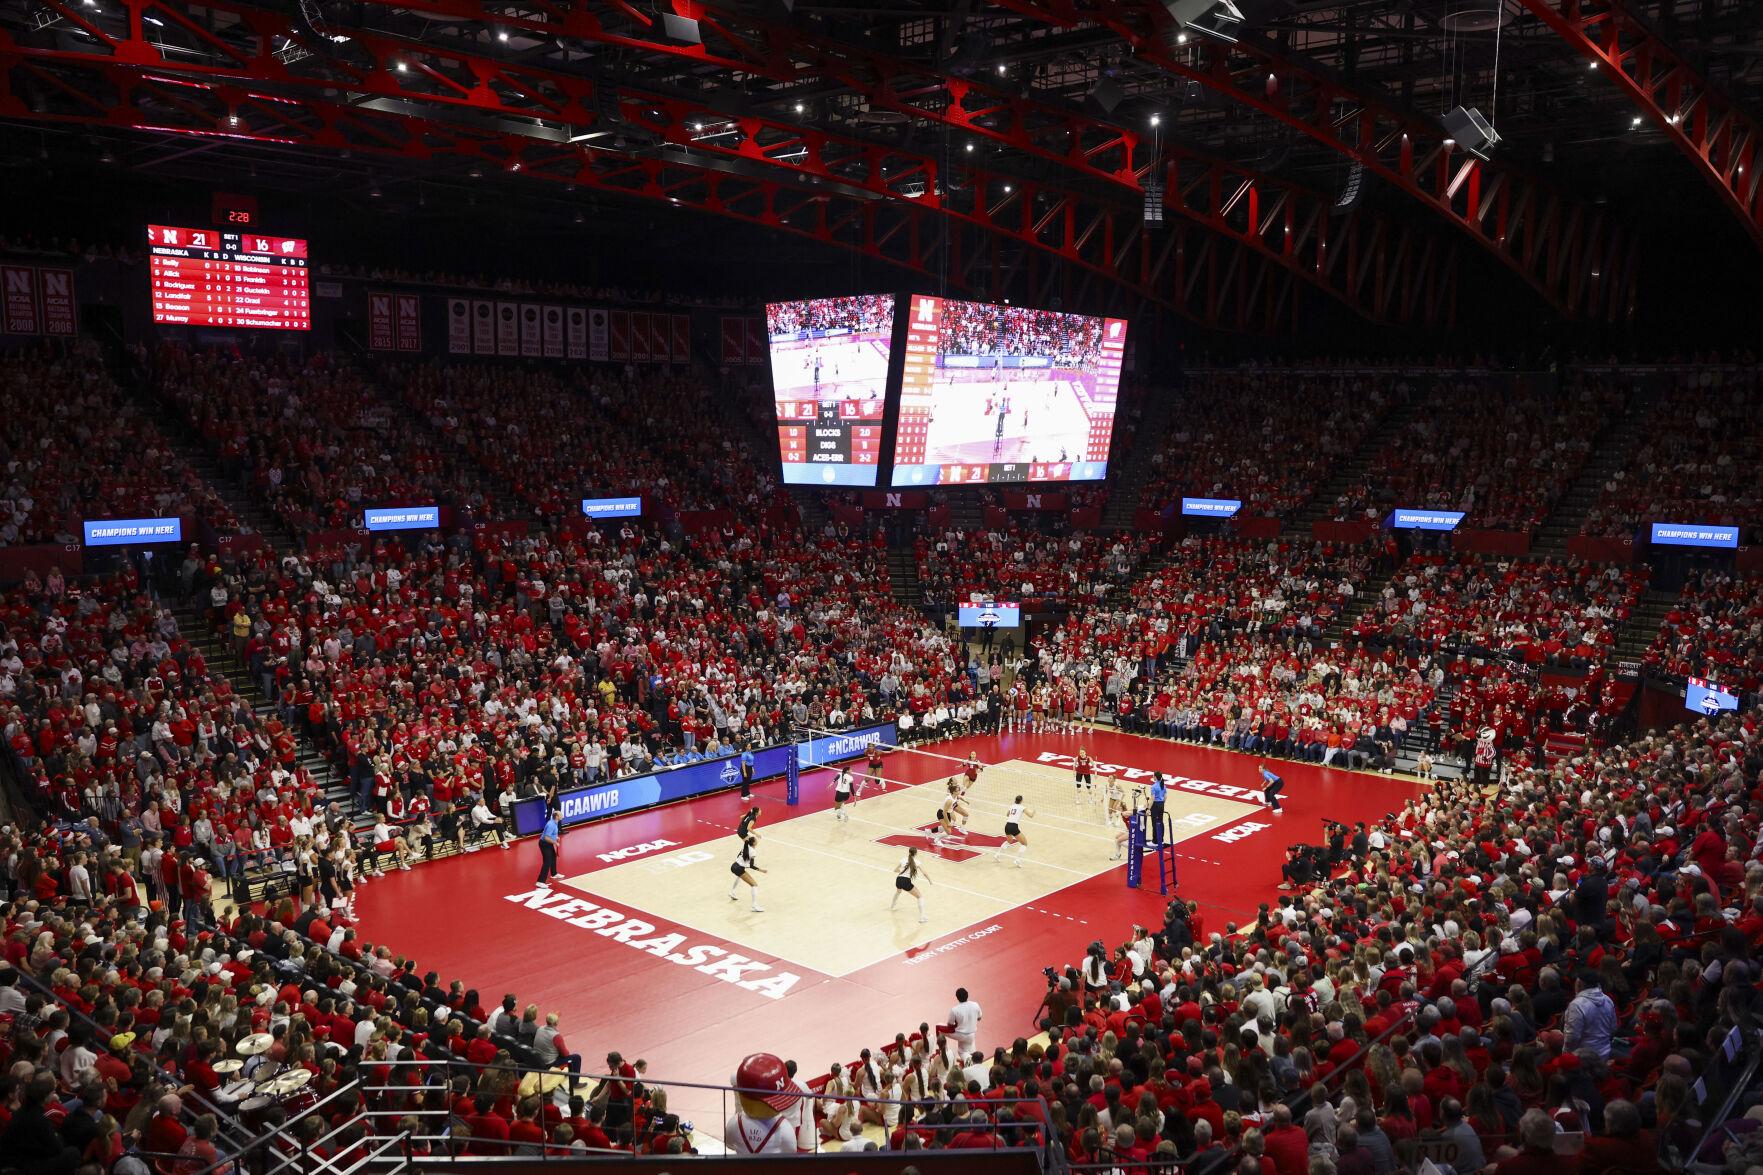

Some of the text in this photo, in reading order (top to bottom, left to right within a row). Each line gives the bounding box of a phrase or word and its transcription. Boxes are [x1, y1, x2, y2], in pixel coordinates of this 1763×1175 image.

[229, 212, 249, 222] 2:28
[163, 230, 177, 244] N
[192, 233, 205, 245] 21
[153, 248, 188, 256] NEBRASKA
[256, 239, 268, 251] 16
[235, 254, 270, 263] WISCONSIN
[6, 271, 32, 293] N
[45, 273, 69, 295] N
[372, 297, 390, 315] N
[400, 299, 416, 317] N
[918, 299, 934, 321] N
[802, 404, 813, 415] 21
[845, 403, 855, 415] 16
[972, 467, 981, 479] 21
[886, 493, 901, 508] N
[1026, 494, 1041, 508] N
[371, 515, 405, 524] CHAMPIONS
[92, 526, 174, 537] CHAMPIONS WIN HERE
[828, 732, 880, 755] #NCAAWVB
[1211, 822, 1268, 843] NCAA
[596, 839, 678, 863] NCAA
[503, 888, 801, 1000] NEBRASKA
[902, 924, 1003, 966] TERRY PETTIT COURT
[776, 1077, 784, 1090] N
